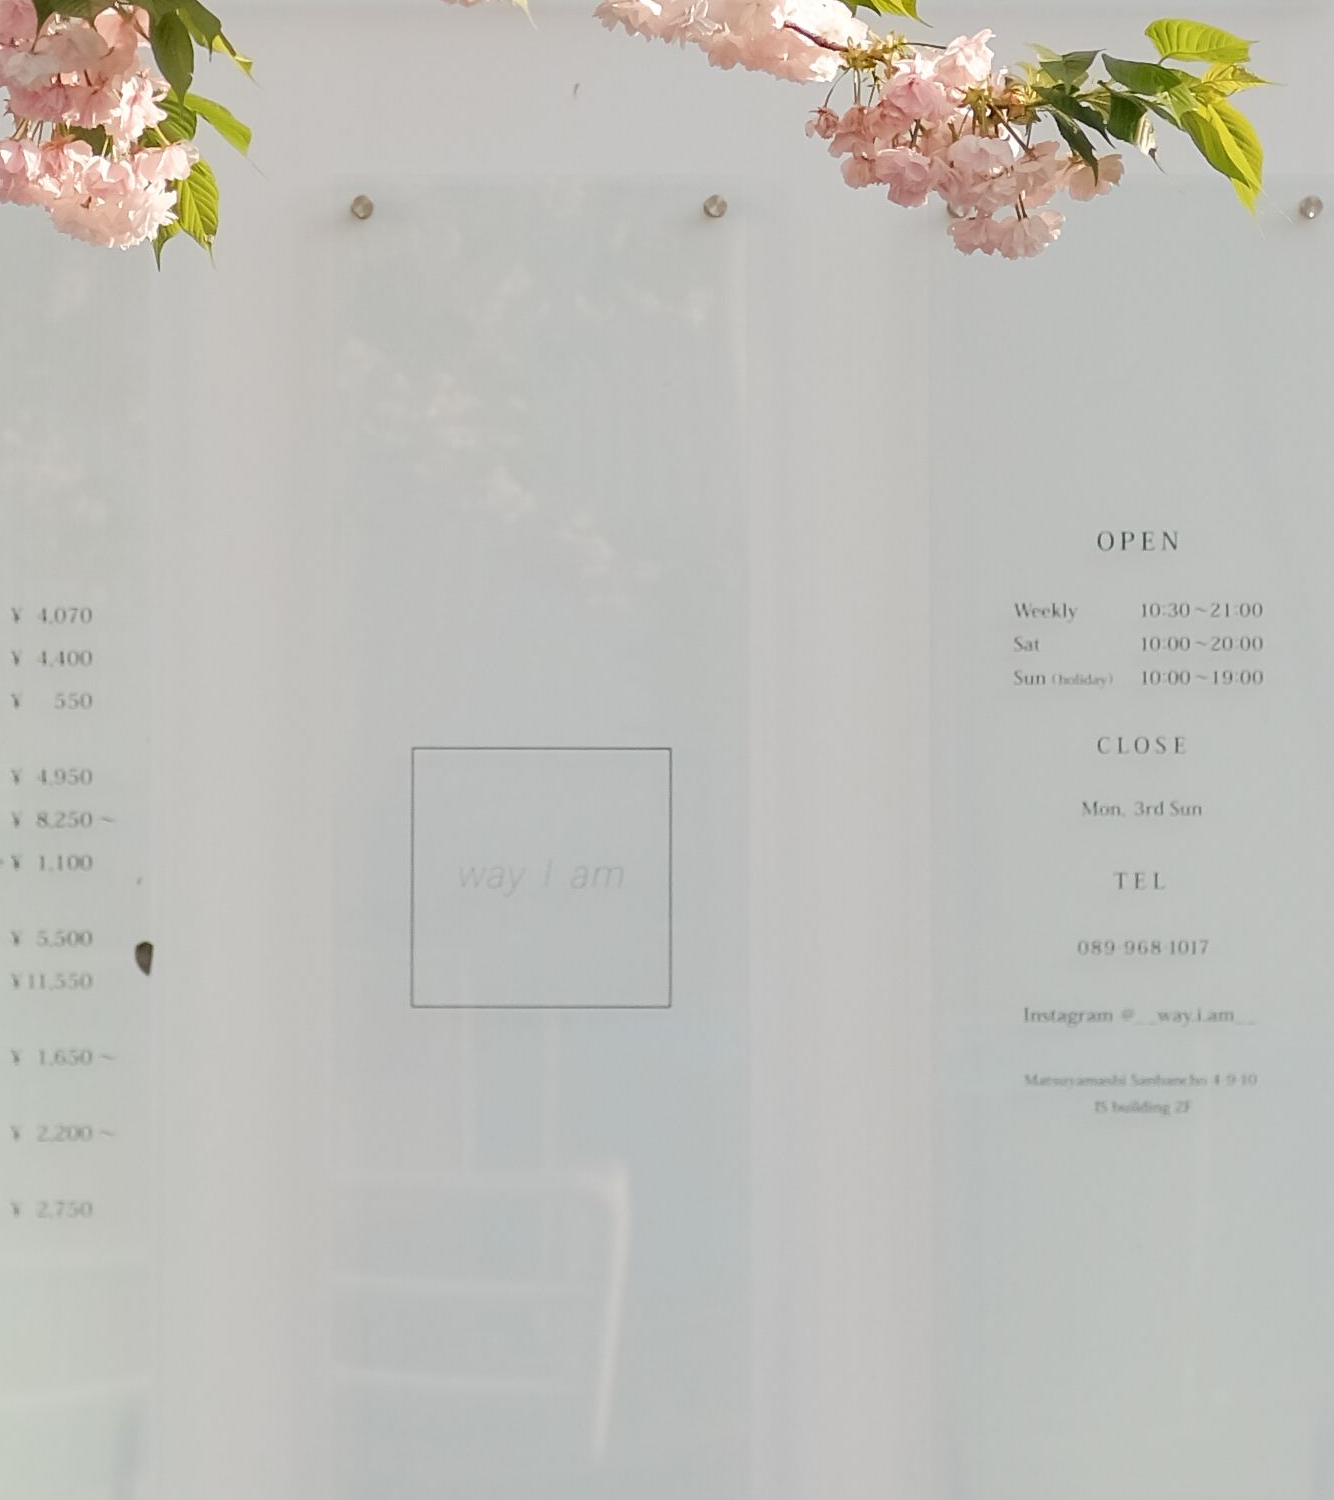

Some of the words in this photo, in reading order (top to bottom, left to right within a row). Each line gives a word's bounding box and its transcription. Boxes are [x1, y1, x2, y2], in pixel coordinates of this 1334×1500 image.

[1096, 531, 1178, 551] OPEN
[1014, 603, 1077, 622] Weekly
[1013, 636, 1040, 652] Sat
[1013, 670, 1046, 685] Sun
[1096, 736, 1187, 755] CLOSE
[1133, 801, 1165, 816] 3rd
[1169, 801, 1203, 816] Sun
[1113, 871, 1166, 890] TEL
[1023, 1007, 1114, 1028] Instagram
